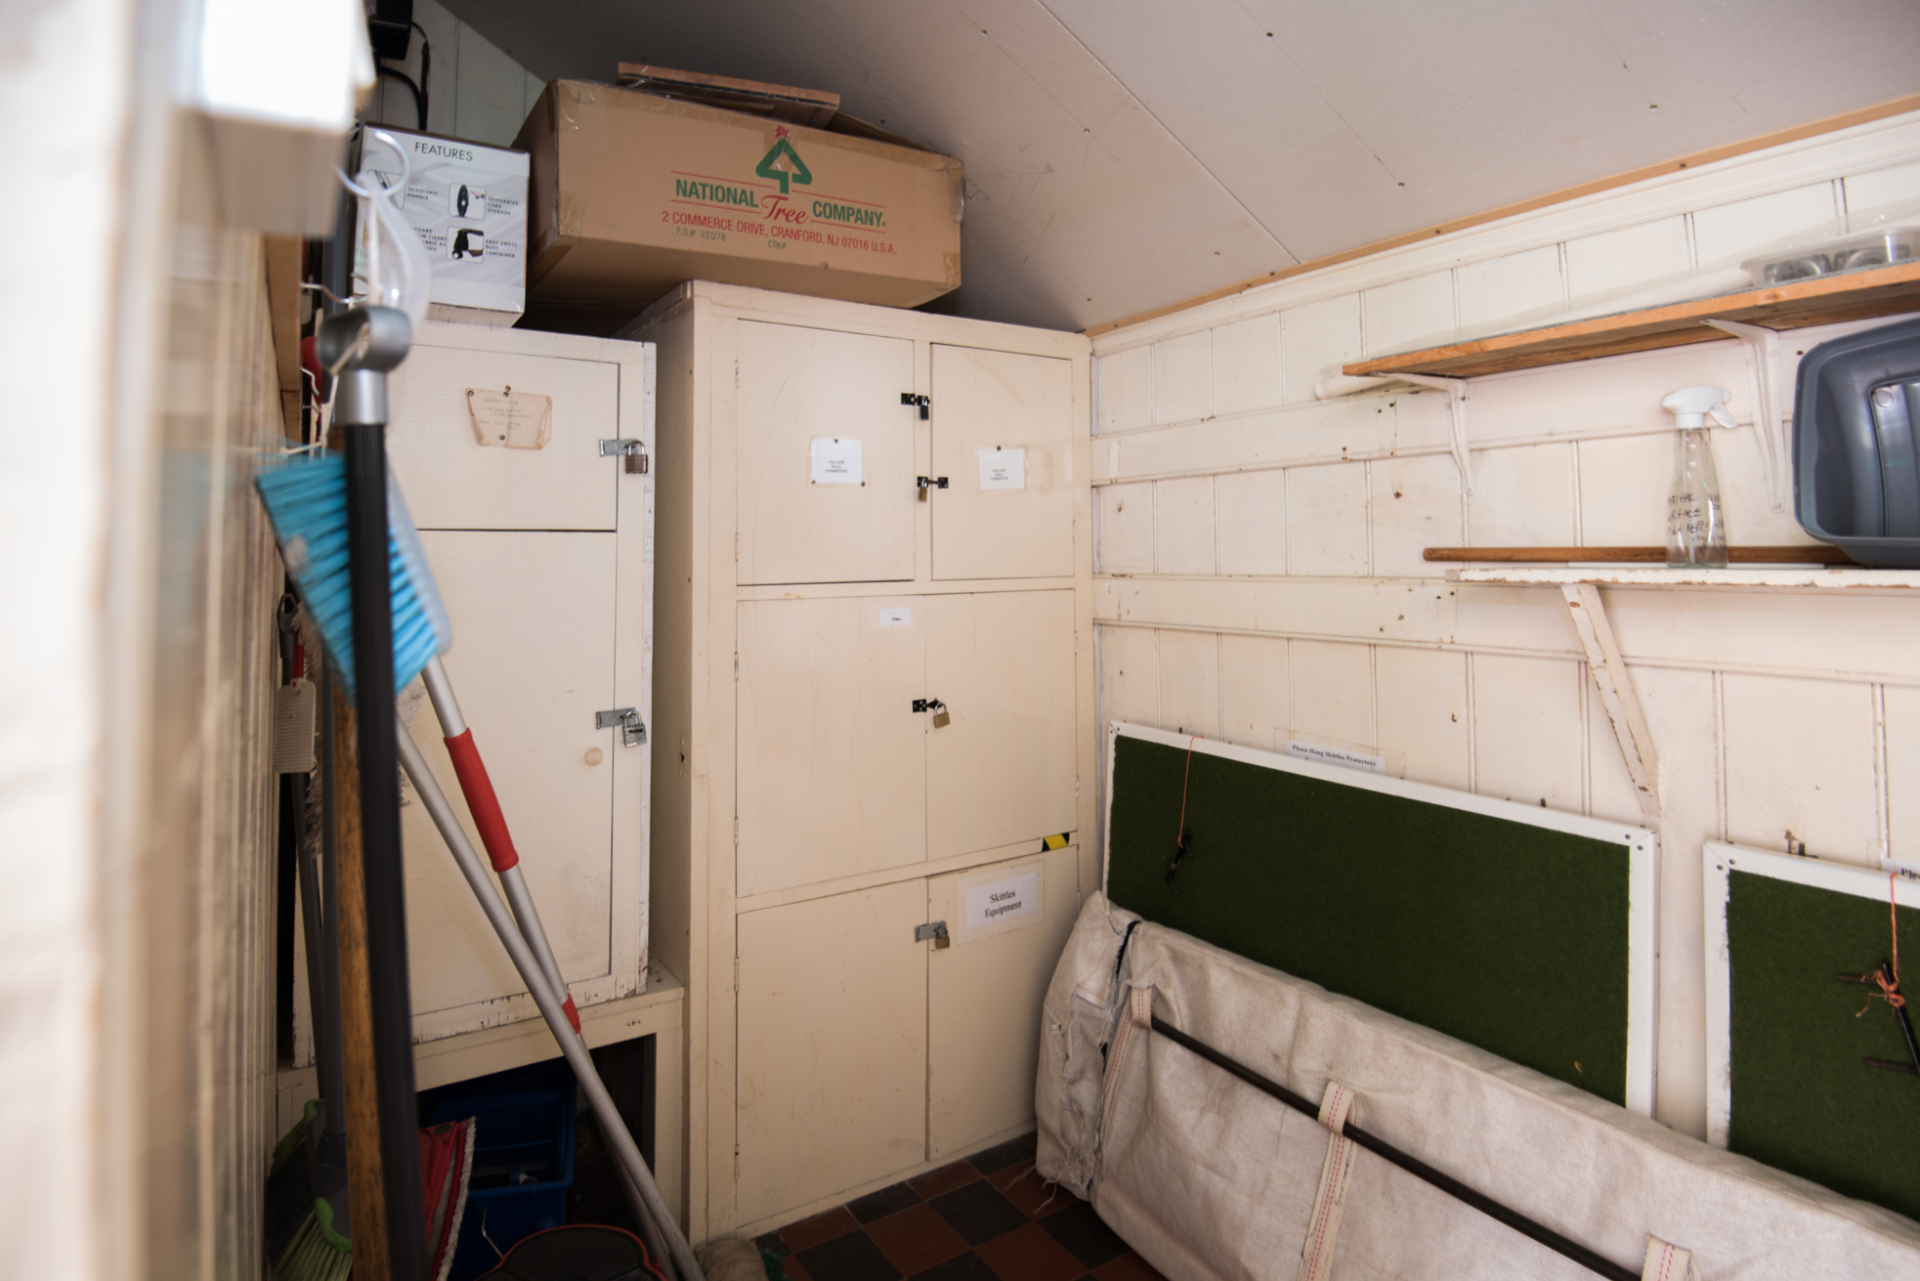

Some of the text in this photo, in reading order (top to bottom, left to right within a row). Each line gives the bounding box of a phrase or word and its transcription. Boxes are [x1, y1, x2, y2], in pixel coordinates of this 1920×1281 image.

[415, 142, 473, 162] FEATURES
[407, 187, 439, 196] TELESCOPIC
[488, 197, 519, 206] INTEGRATED
[675, 179, 759, 208] NATIONAL
[761, 194, 809, 225] Tree
[487, 208, 511, 216] STORAGE
[662, 210, 897, 255] 2 COMMERCE DRIVE, CRANFORD, NJ 07016 U.S.A.
[676, 226, 726, 242] P.O.# 021278
[767, 239, 787, 250] CTN#
[485, 250, 515, 259] CONTAINER
[1292, 745, 1376, 767] Please Hang Skittles Protectors
[989, 890, 1016, 903] Skittles
[985, 900, 1022, 918] Equipment
